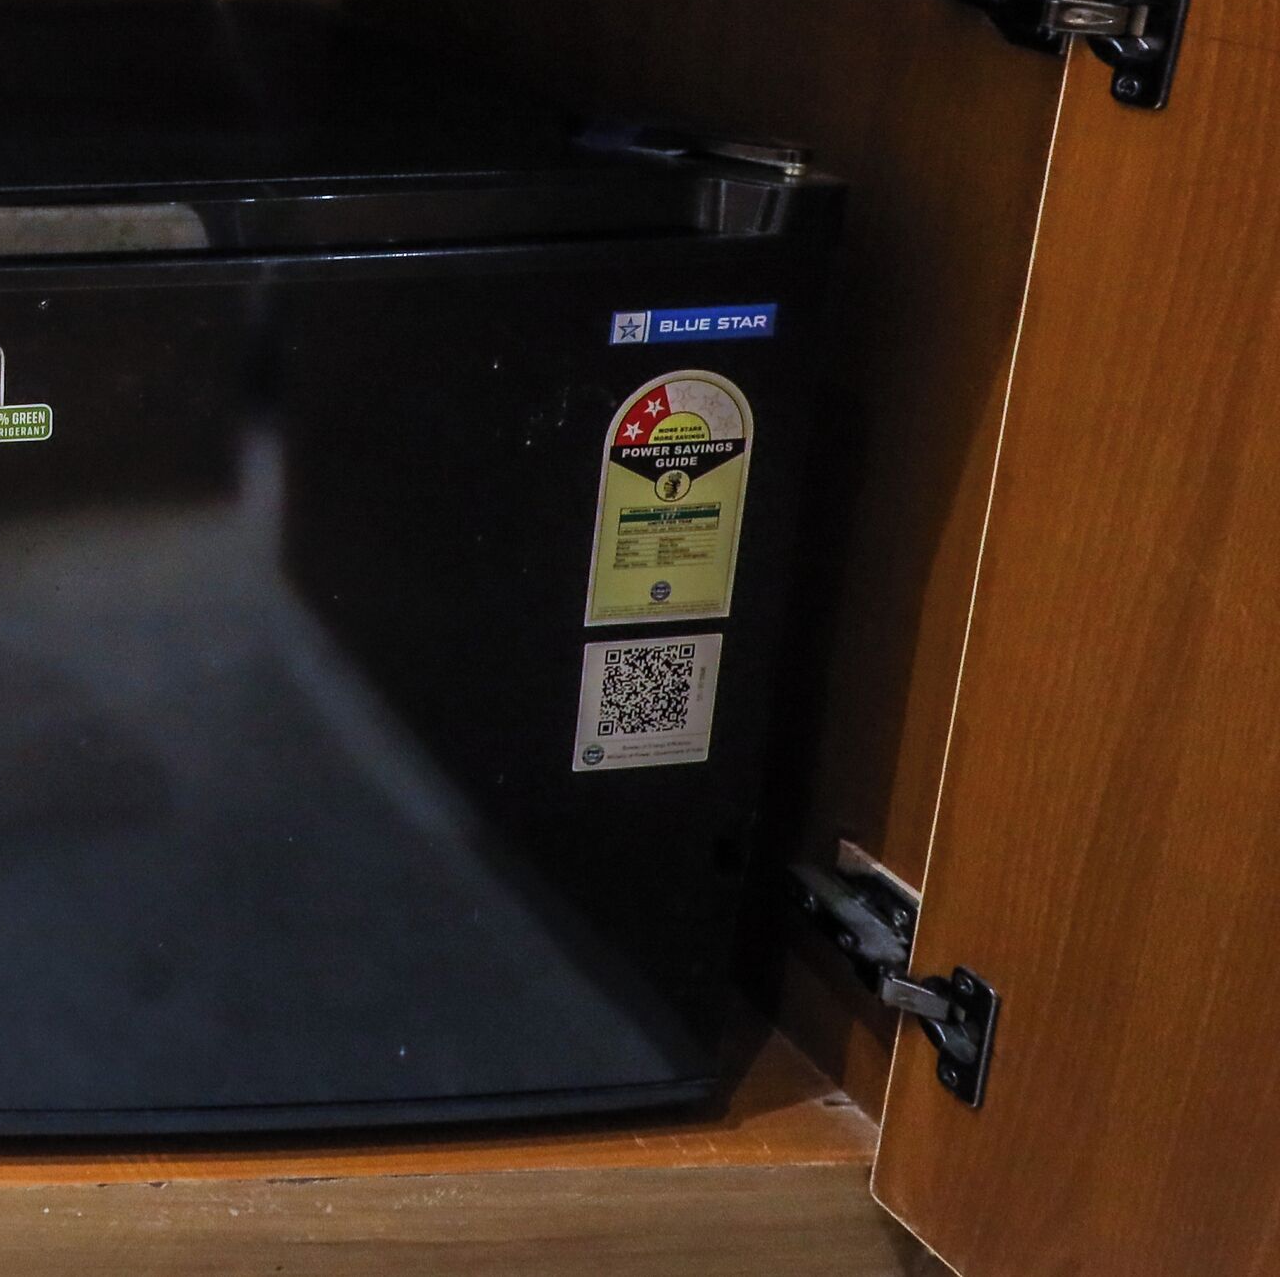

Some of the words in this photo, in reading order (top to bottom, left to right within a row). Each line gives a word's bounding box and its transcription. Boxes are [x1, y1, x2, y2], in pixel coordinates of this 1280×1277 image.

[659, 318, 710, 332] BLUE
[717, 315, 767, 330] STAR
[12, 411, 46, 425] GREEN
[621, 445, 670, 458] POWER
[674, 442, 733, 455] SAVINGS
[655, 456, 698, 468] GUIDE
